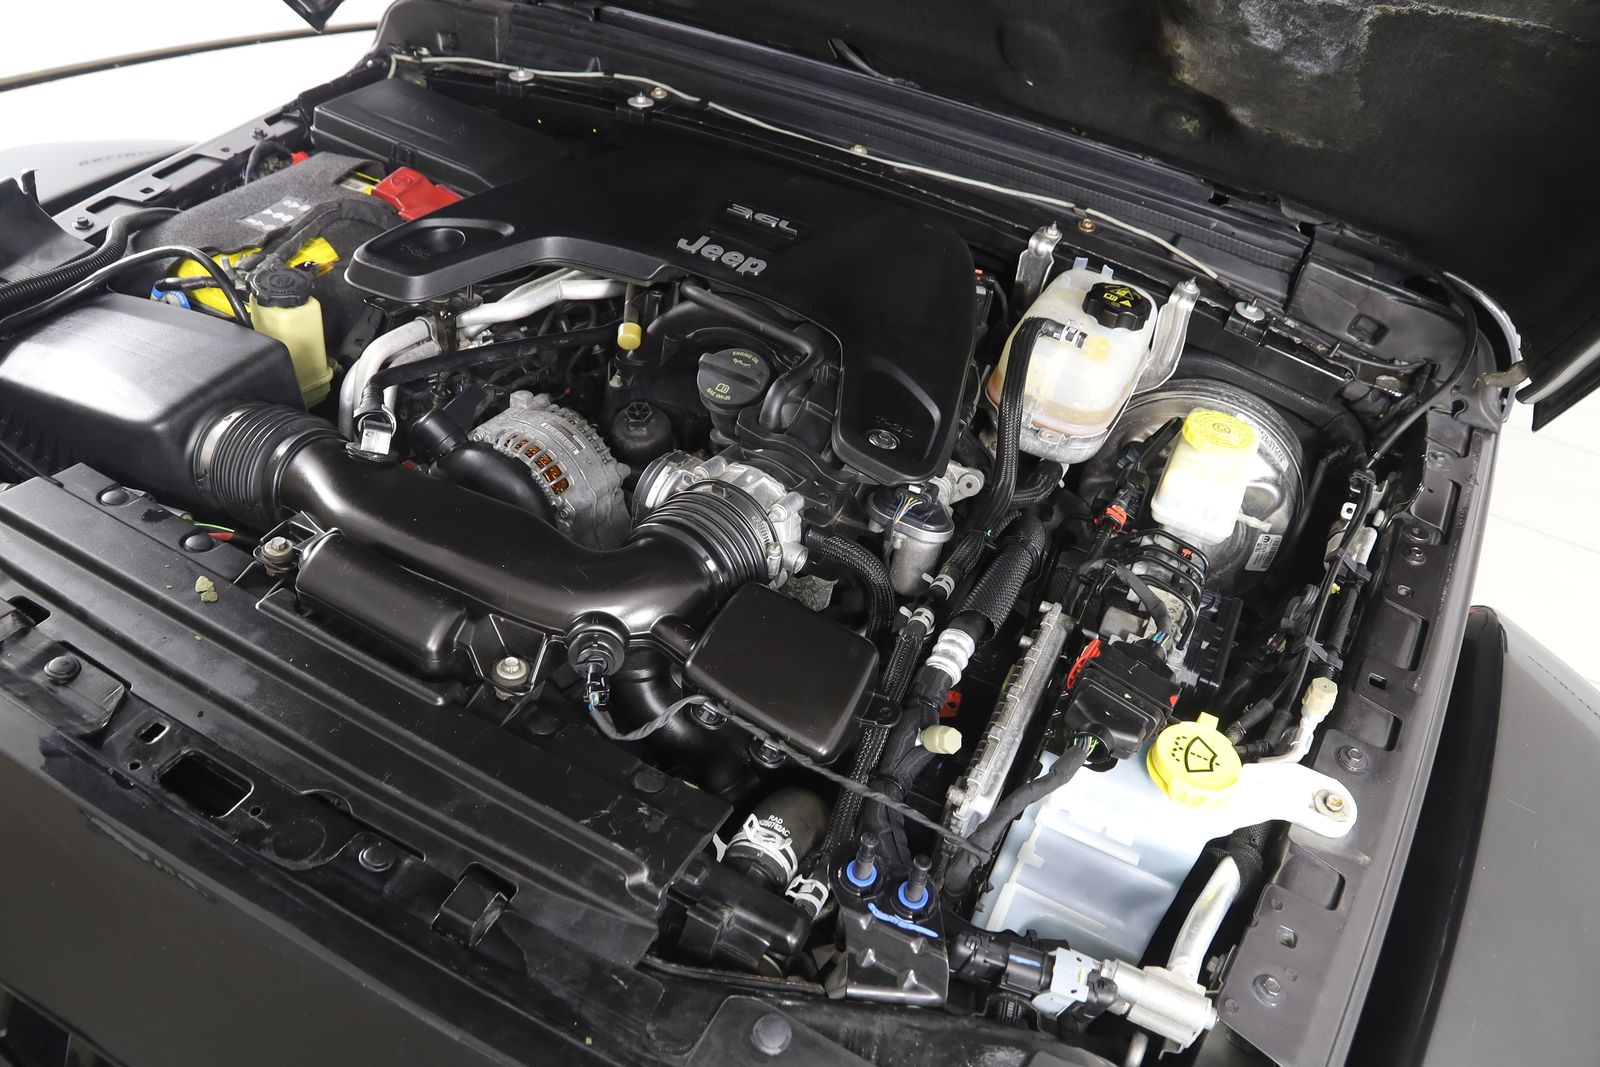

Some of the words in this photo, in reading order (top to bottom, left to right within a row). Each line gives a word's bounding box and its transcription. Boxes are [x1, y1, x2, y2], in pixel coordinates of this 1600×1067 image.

[676, 235, 768, 276] Jeep
[732, 351, 753, 359] ENGINE
[768, 815, 783, 824] RAD
